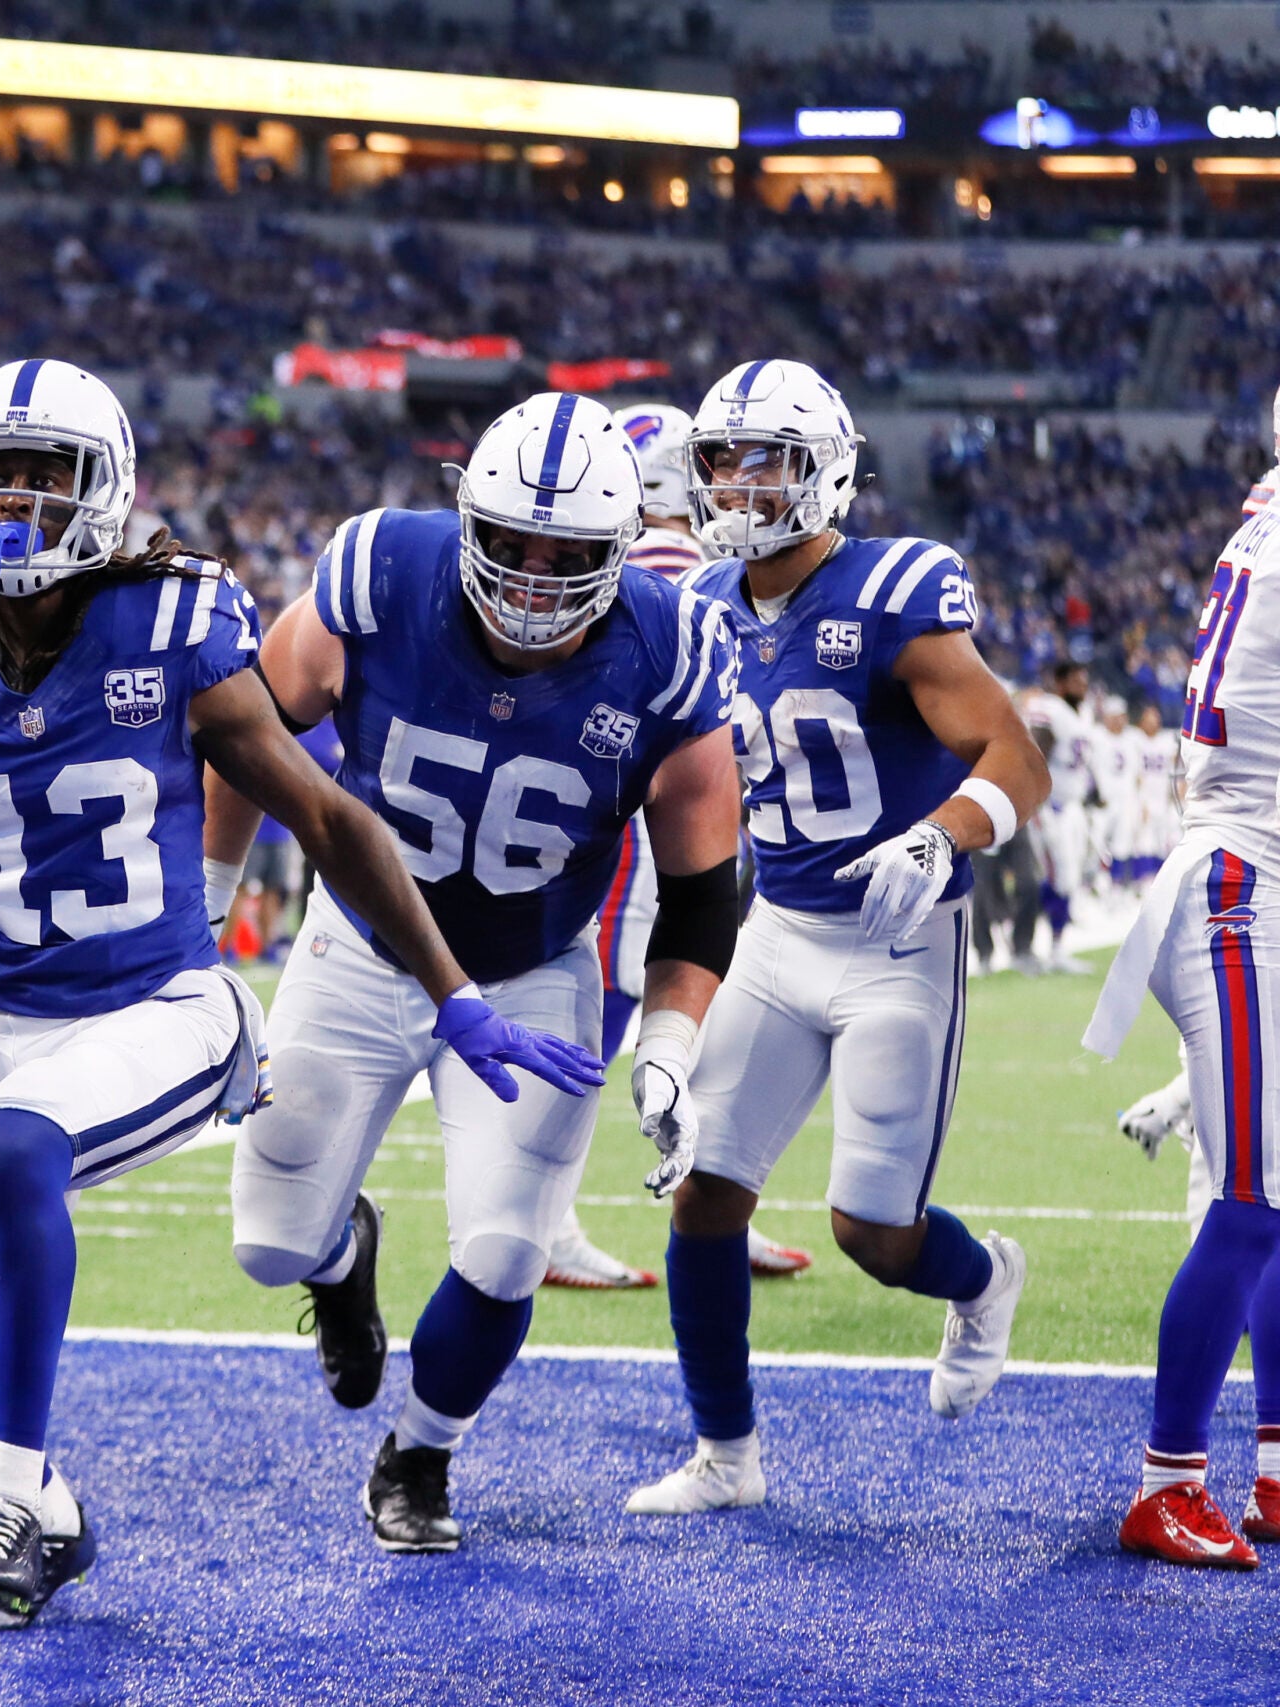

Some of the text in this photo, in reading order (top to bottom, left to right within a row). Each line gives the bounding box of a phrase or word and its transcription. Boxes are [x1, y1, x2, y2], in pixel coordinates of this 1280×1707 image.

[6, 411, 28, 422] COLTS
[532, 508, 552, 522] COLTS
[939, 574, 979, 623] 20
[818, 621, 860, 653] 35
[1182, 561, 1252, 747] 21
[108, 669, 162, 707] 35
[117, 702, 155, 712] SEASONS
[586, 706, 637, 746] 35
[730, 688, 883, 844] 20
[379, 716, 592, 896] 56
